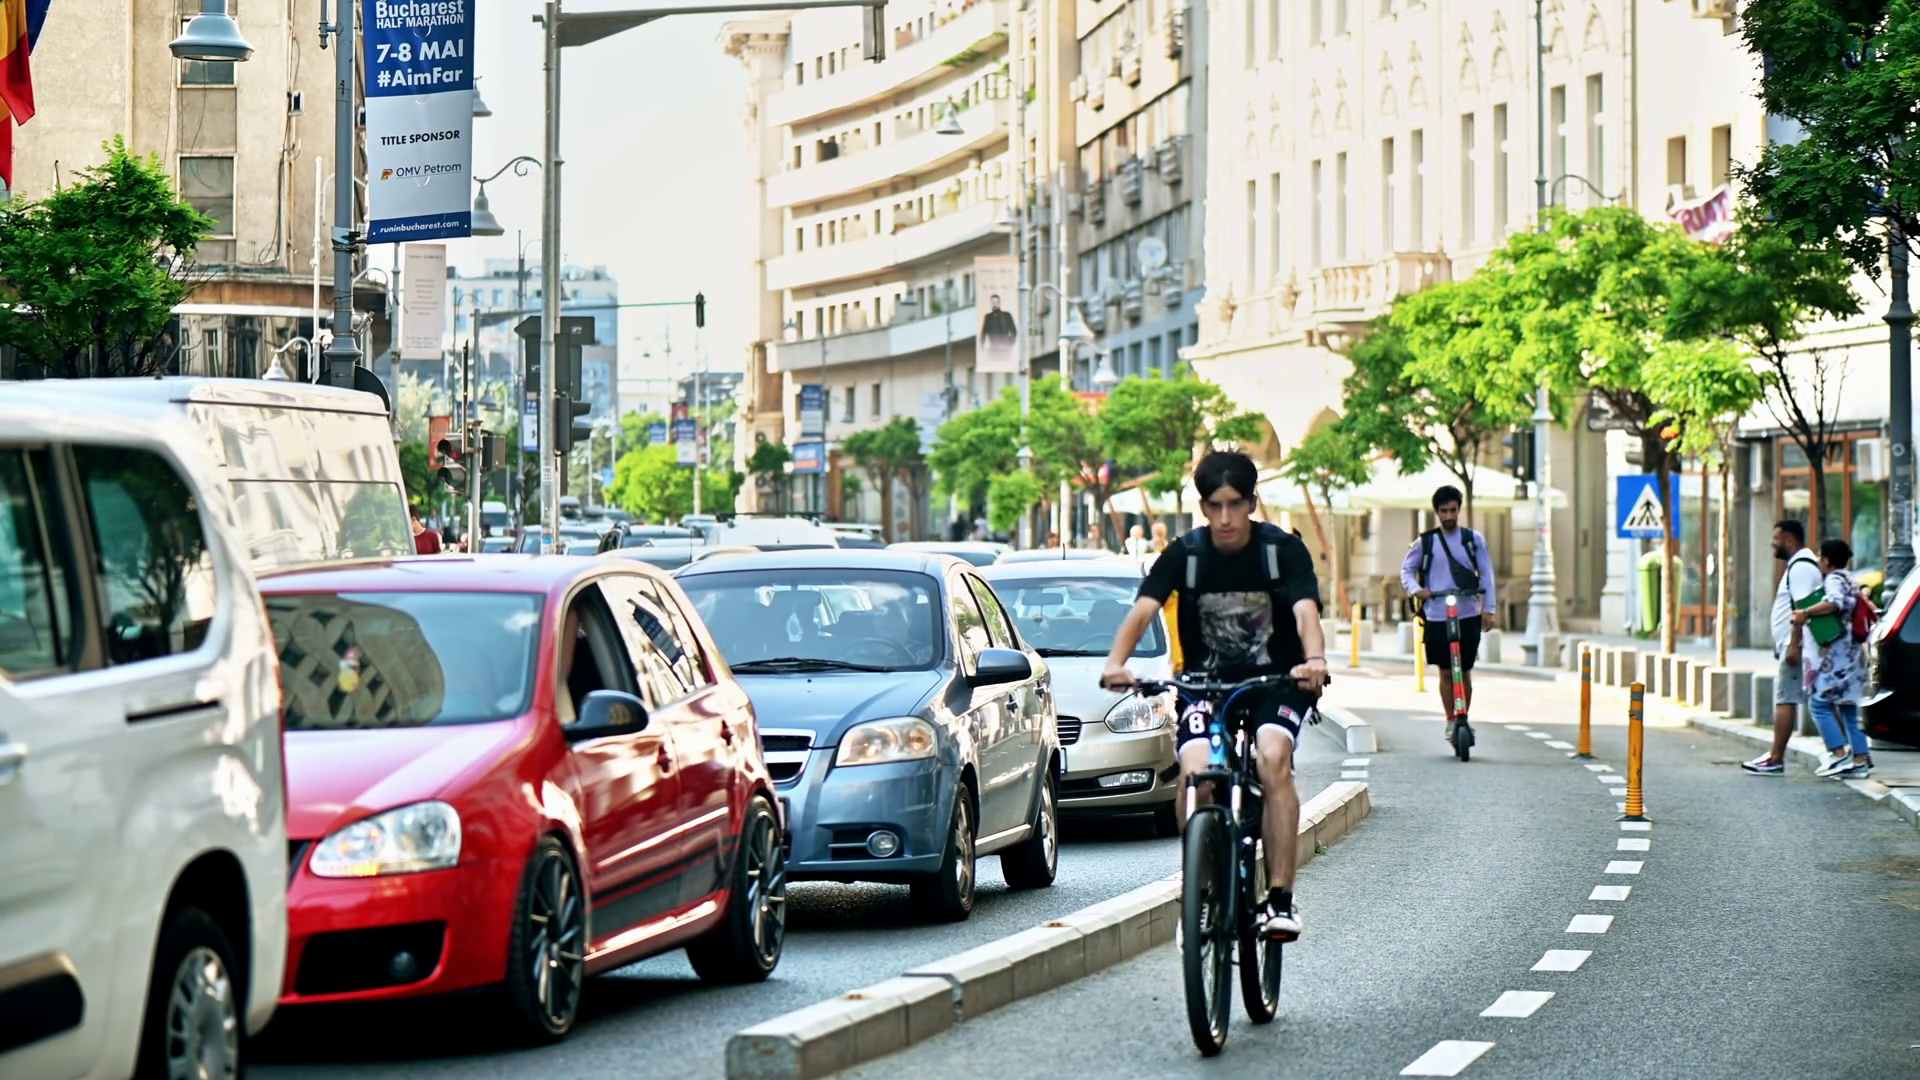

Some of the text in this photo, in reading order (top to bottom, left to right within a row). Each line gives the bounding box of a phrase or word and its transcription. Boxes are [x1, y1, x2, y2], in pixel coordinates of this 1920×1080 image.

[375, 0, 464, 18] Bucharest
[376, 14, 464, 29] HALF MARATHON
[376, 39, 464, 63] 7-8 MAI
[377, 67, 463, 87] #AimFar
[381, 130, 460, 146] TITLE SPONSOR
[396, 163, 462, 177] OMV Petrom
[380, 221, 460, 233] runinbucharest.com
[1189, 712, 1205, 734] 8
